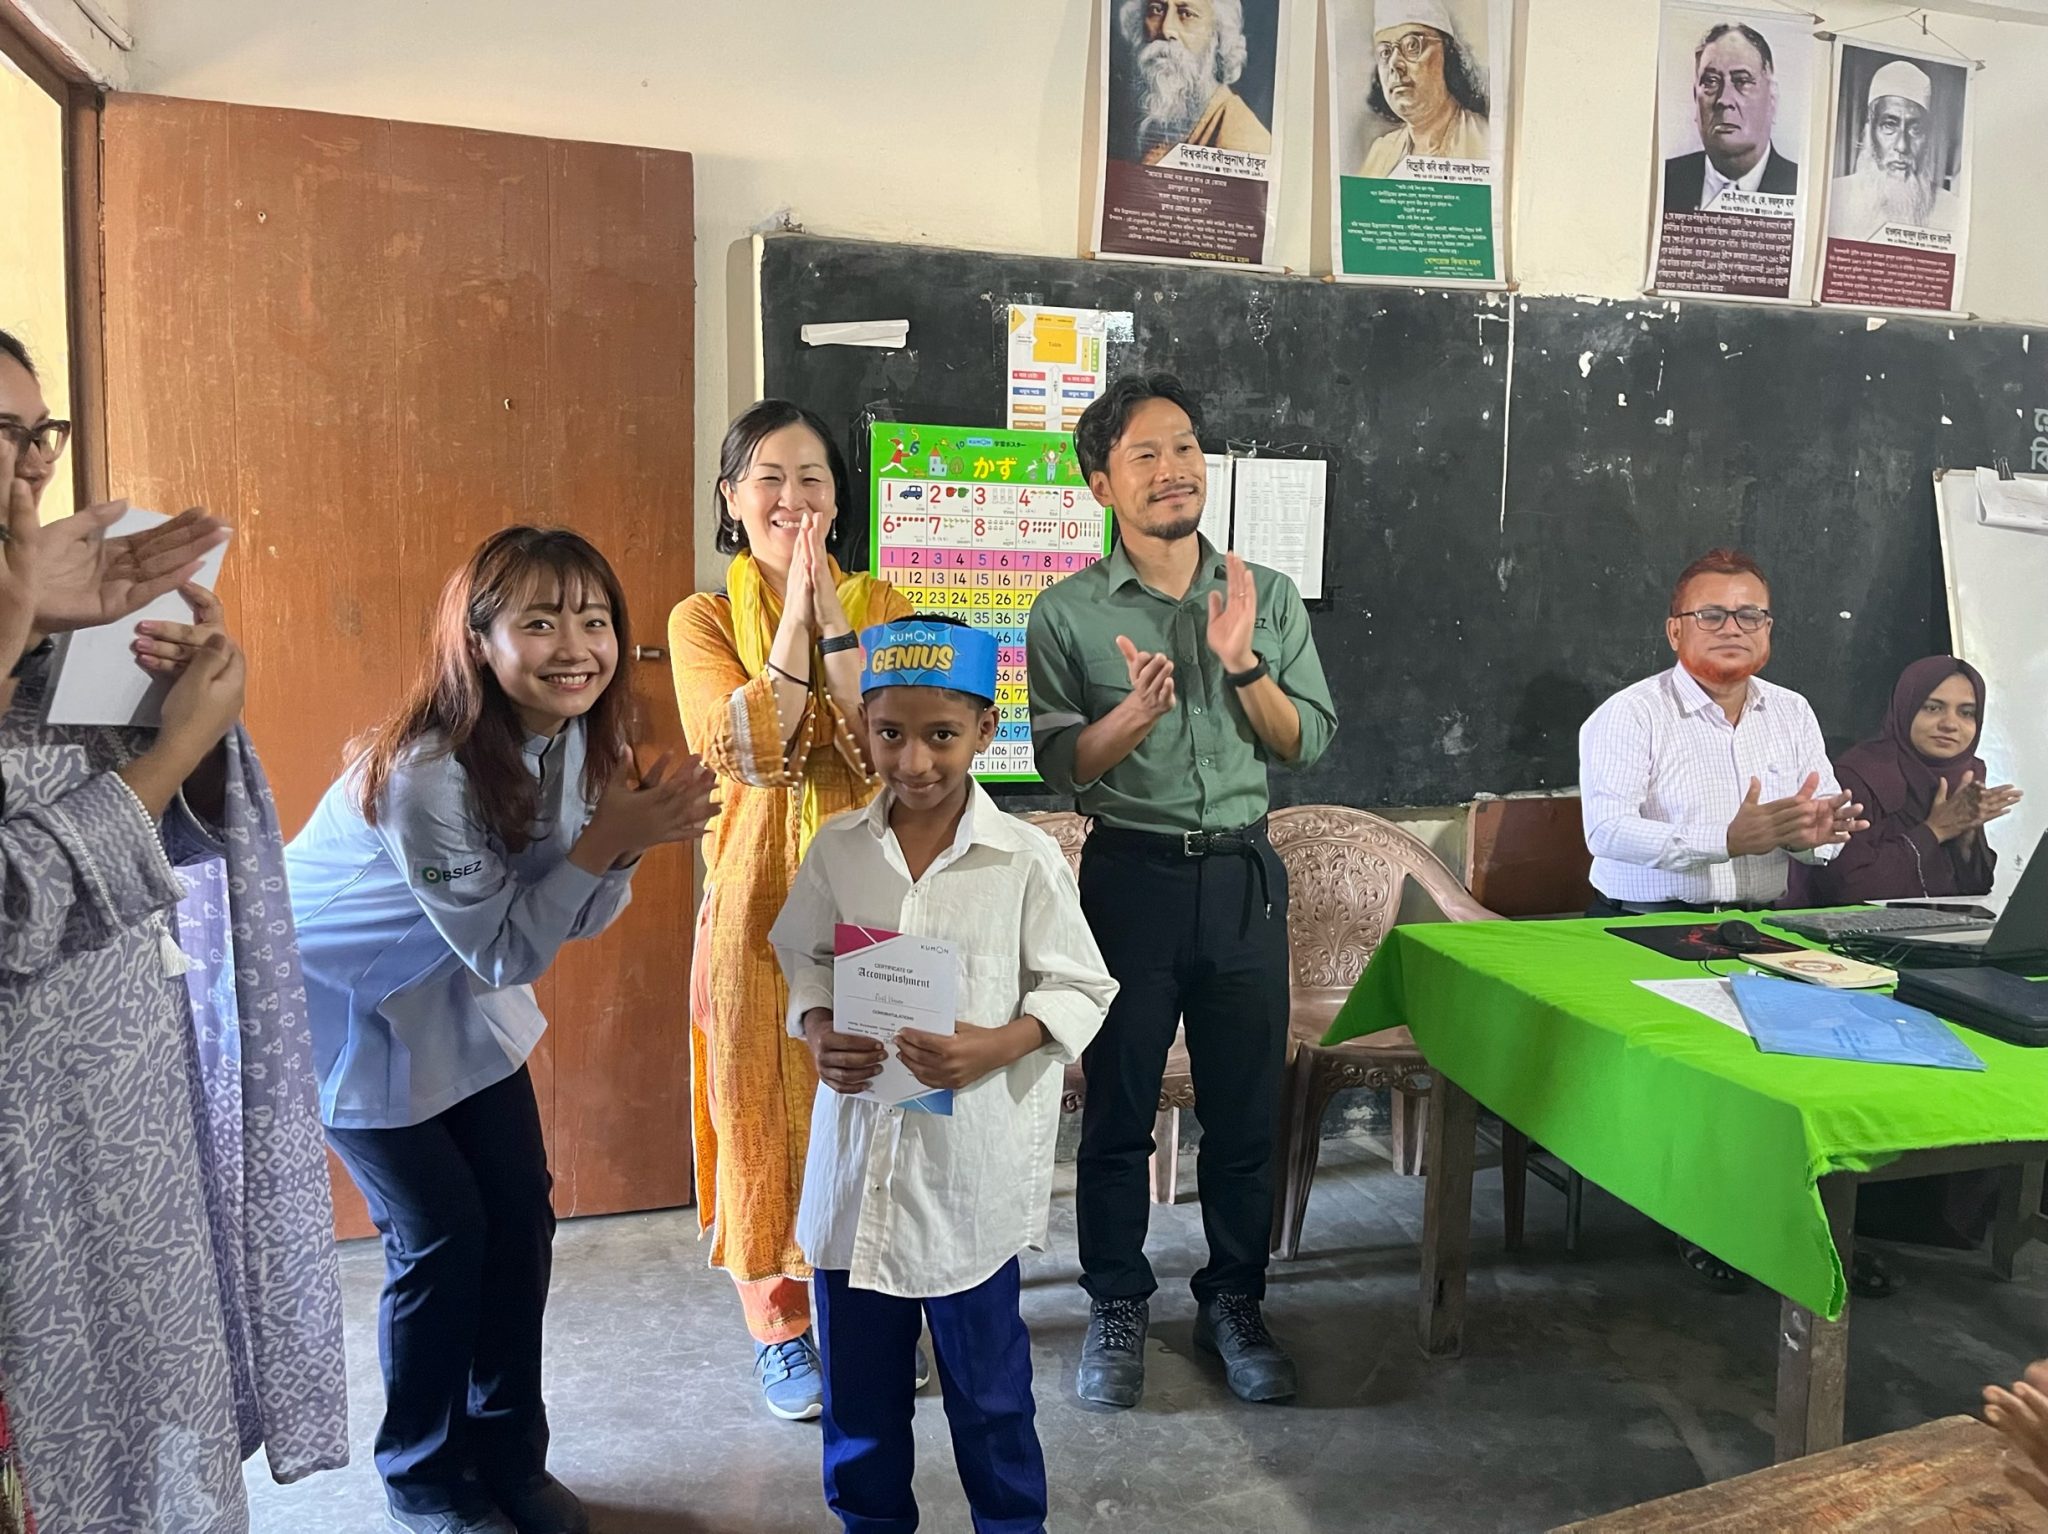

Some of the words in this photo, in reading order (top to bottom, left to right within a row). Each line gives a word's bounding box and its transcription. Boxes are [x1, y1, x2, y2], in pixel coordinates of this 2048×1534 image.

[1180, 145, 1209, 161] বিশ্বকবি
[1211, 149, 1245, 167] রবীন্দ্রনাথ
[1247, 153, 1266, 172] ঠাকুর
[973, 456, 1018, 480] かず
[887, 482, 892, 502] 1
[929, 485, 941, 503] 2
[973, 487, 986, 505] 3
[1018, 488, 1031, 507] 4
[1062, 490, 1074, 508] 5
[883, 515, 895, 533] 6
[929, 516, 941, 535] 7
[974, 518, 985, 536] 8
[1018, 519, 1030, 538] 9
[1061, 521, 1078, 539] 10
[911, 552, 919, 564] 2
[934, 552, 942, 564] 3
[956, 553, 964, 565] 4
[978, 554, 987, 566] 5
[1000, 555, 1008, 567] 6
[1022, 555, 1030, 567] 7
[1044, 556, 1052, 568] 8
[1065, 556, 1073, 568] 9
[1085, 557, 1097, 568] 10
[887, 570, 898, 583] 11
[909, 571, 922, 584] 12
[932, 572, 945, 584] 13
[954, 572, 967, 585] 14
[976, 573, 989, 586] 15
[998, 574, 1011, 586] 16
[1020, 574, 1032, 586] 17
[1041, 575, 1054, 587] 18
[906, 591, 923, 603] 22
[929, 592, 946, 604] 23
[951, 592, 968, 604] 24
[974, 593, 990, 605] 25
[995, 593, 1012, 606] 26
[1017, 594, 1033, 606] 27
[973, 612, 990, 624] 35
[995, 613, 1011, 624] 36
[889, 630, 936, 642] KUMON
[995, 632, 1011, 644] 46
[871, 644, 955, 675] GENIUS
[995, 688, 1009, 700] 76
[1014, 707, 1029, 719] 87
[1013, 726, 1030, 738] 97
[992, 746, 1007, 755] 106
[1013, 746, 1029, 755] 107
[992, 761, 1007, 770] 116
[1013, 761, 1028, 770] 117
[442, 860, 483, 882] BSEZ
[920, 944, 949, 954] KUMON
[874, 963, 906, 974] CERTIFICATE
[857, 966, 930, 989] Accomplishment
